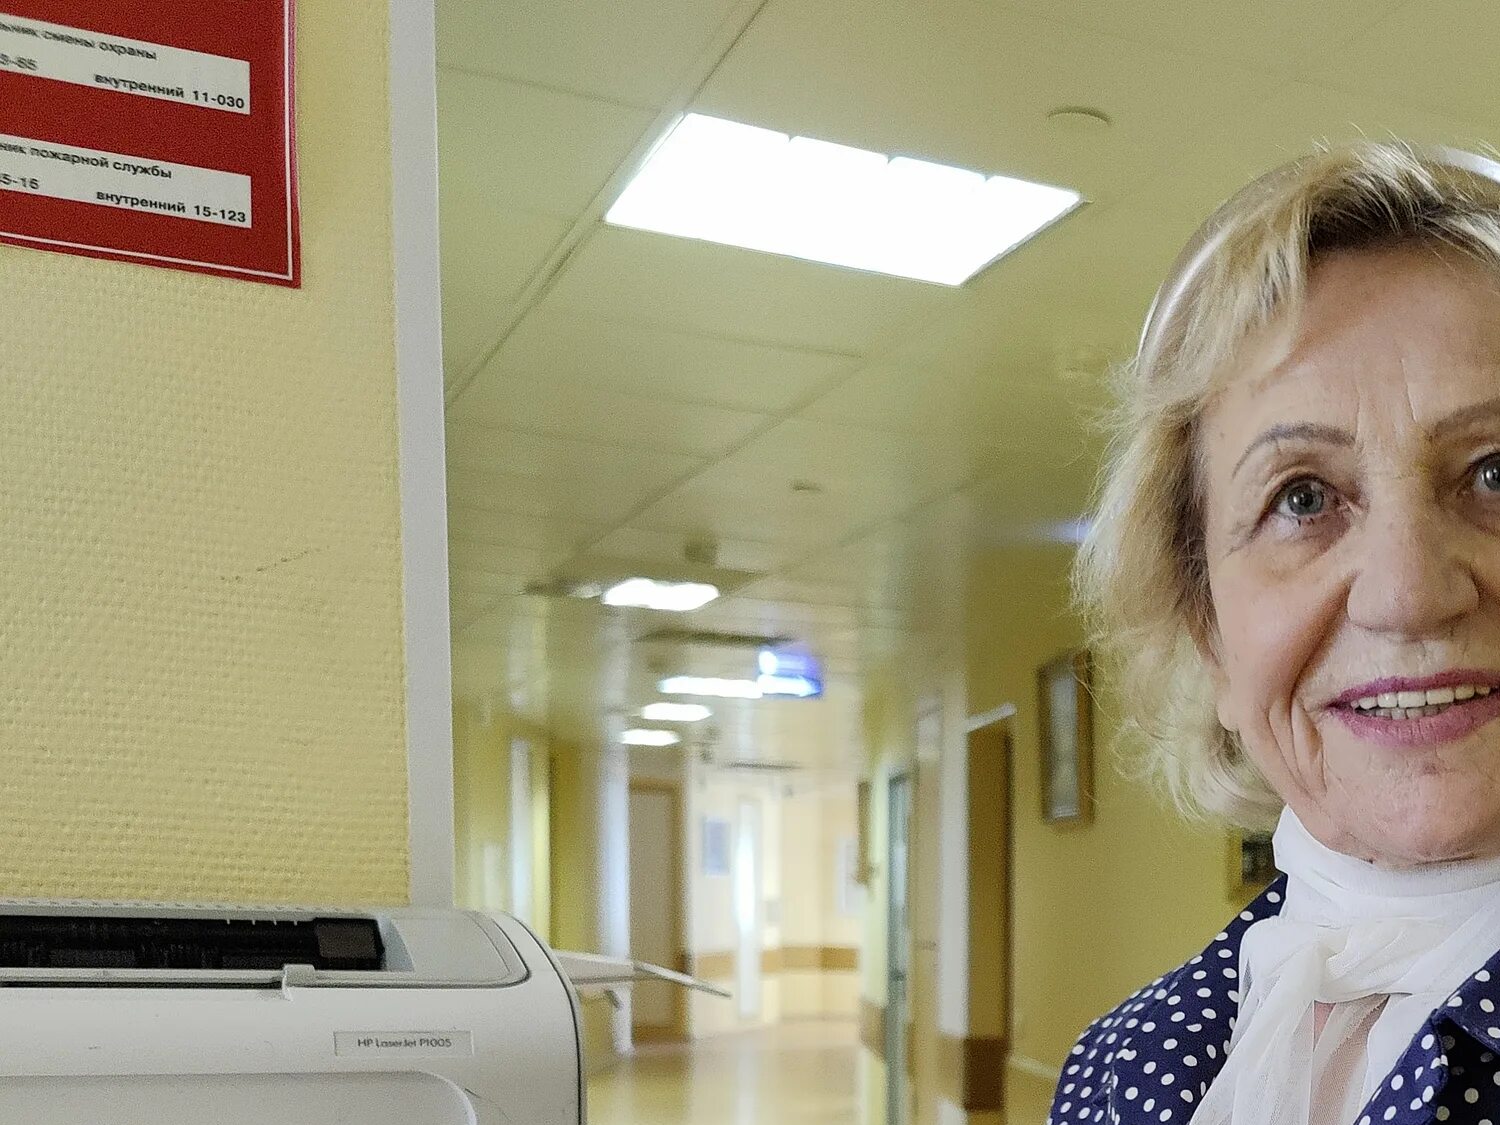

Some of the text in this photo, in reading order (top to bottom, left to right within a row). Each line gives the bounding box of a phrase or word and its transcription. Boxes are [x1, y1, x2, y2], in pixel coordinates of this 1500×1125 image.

[41, 30, 95, 49] смены
[99, 41, 157, 60] охраны
[94, 73, 184, 98] внутренний
[193, 90, 245, 109] 11-030
[30, 147, 109, 169] пожарной
[113, 160, 172, 179] службы
[96, 191, 186, 214] внутренний
[194, 205, 246, 223] 15-123
[358, 1038, 452, 1048] HP LaserJet P1005
